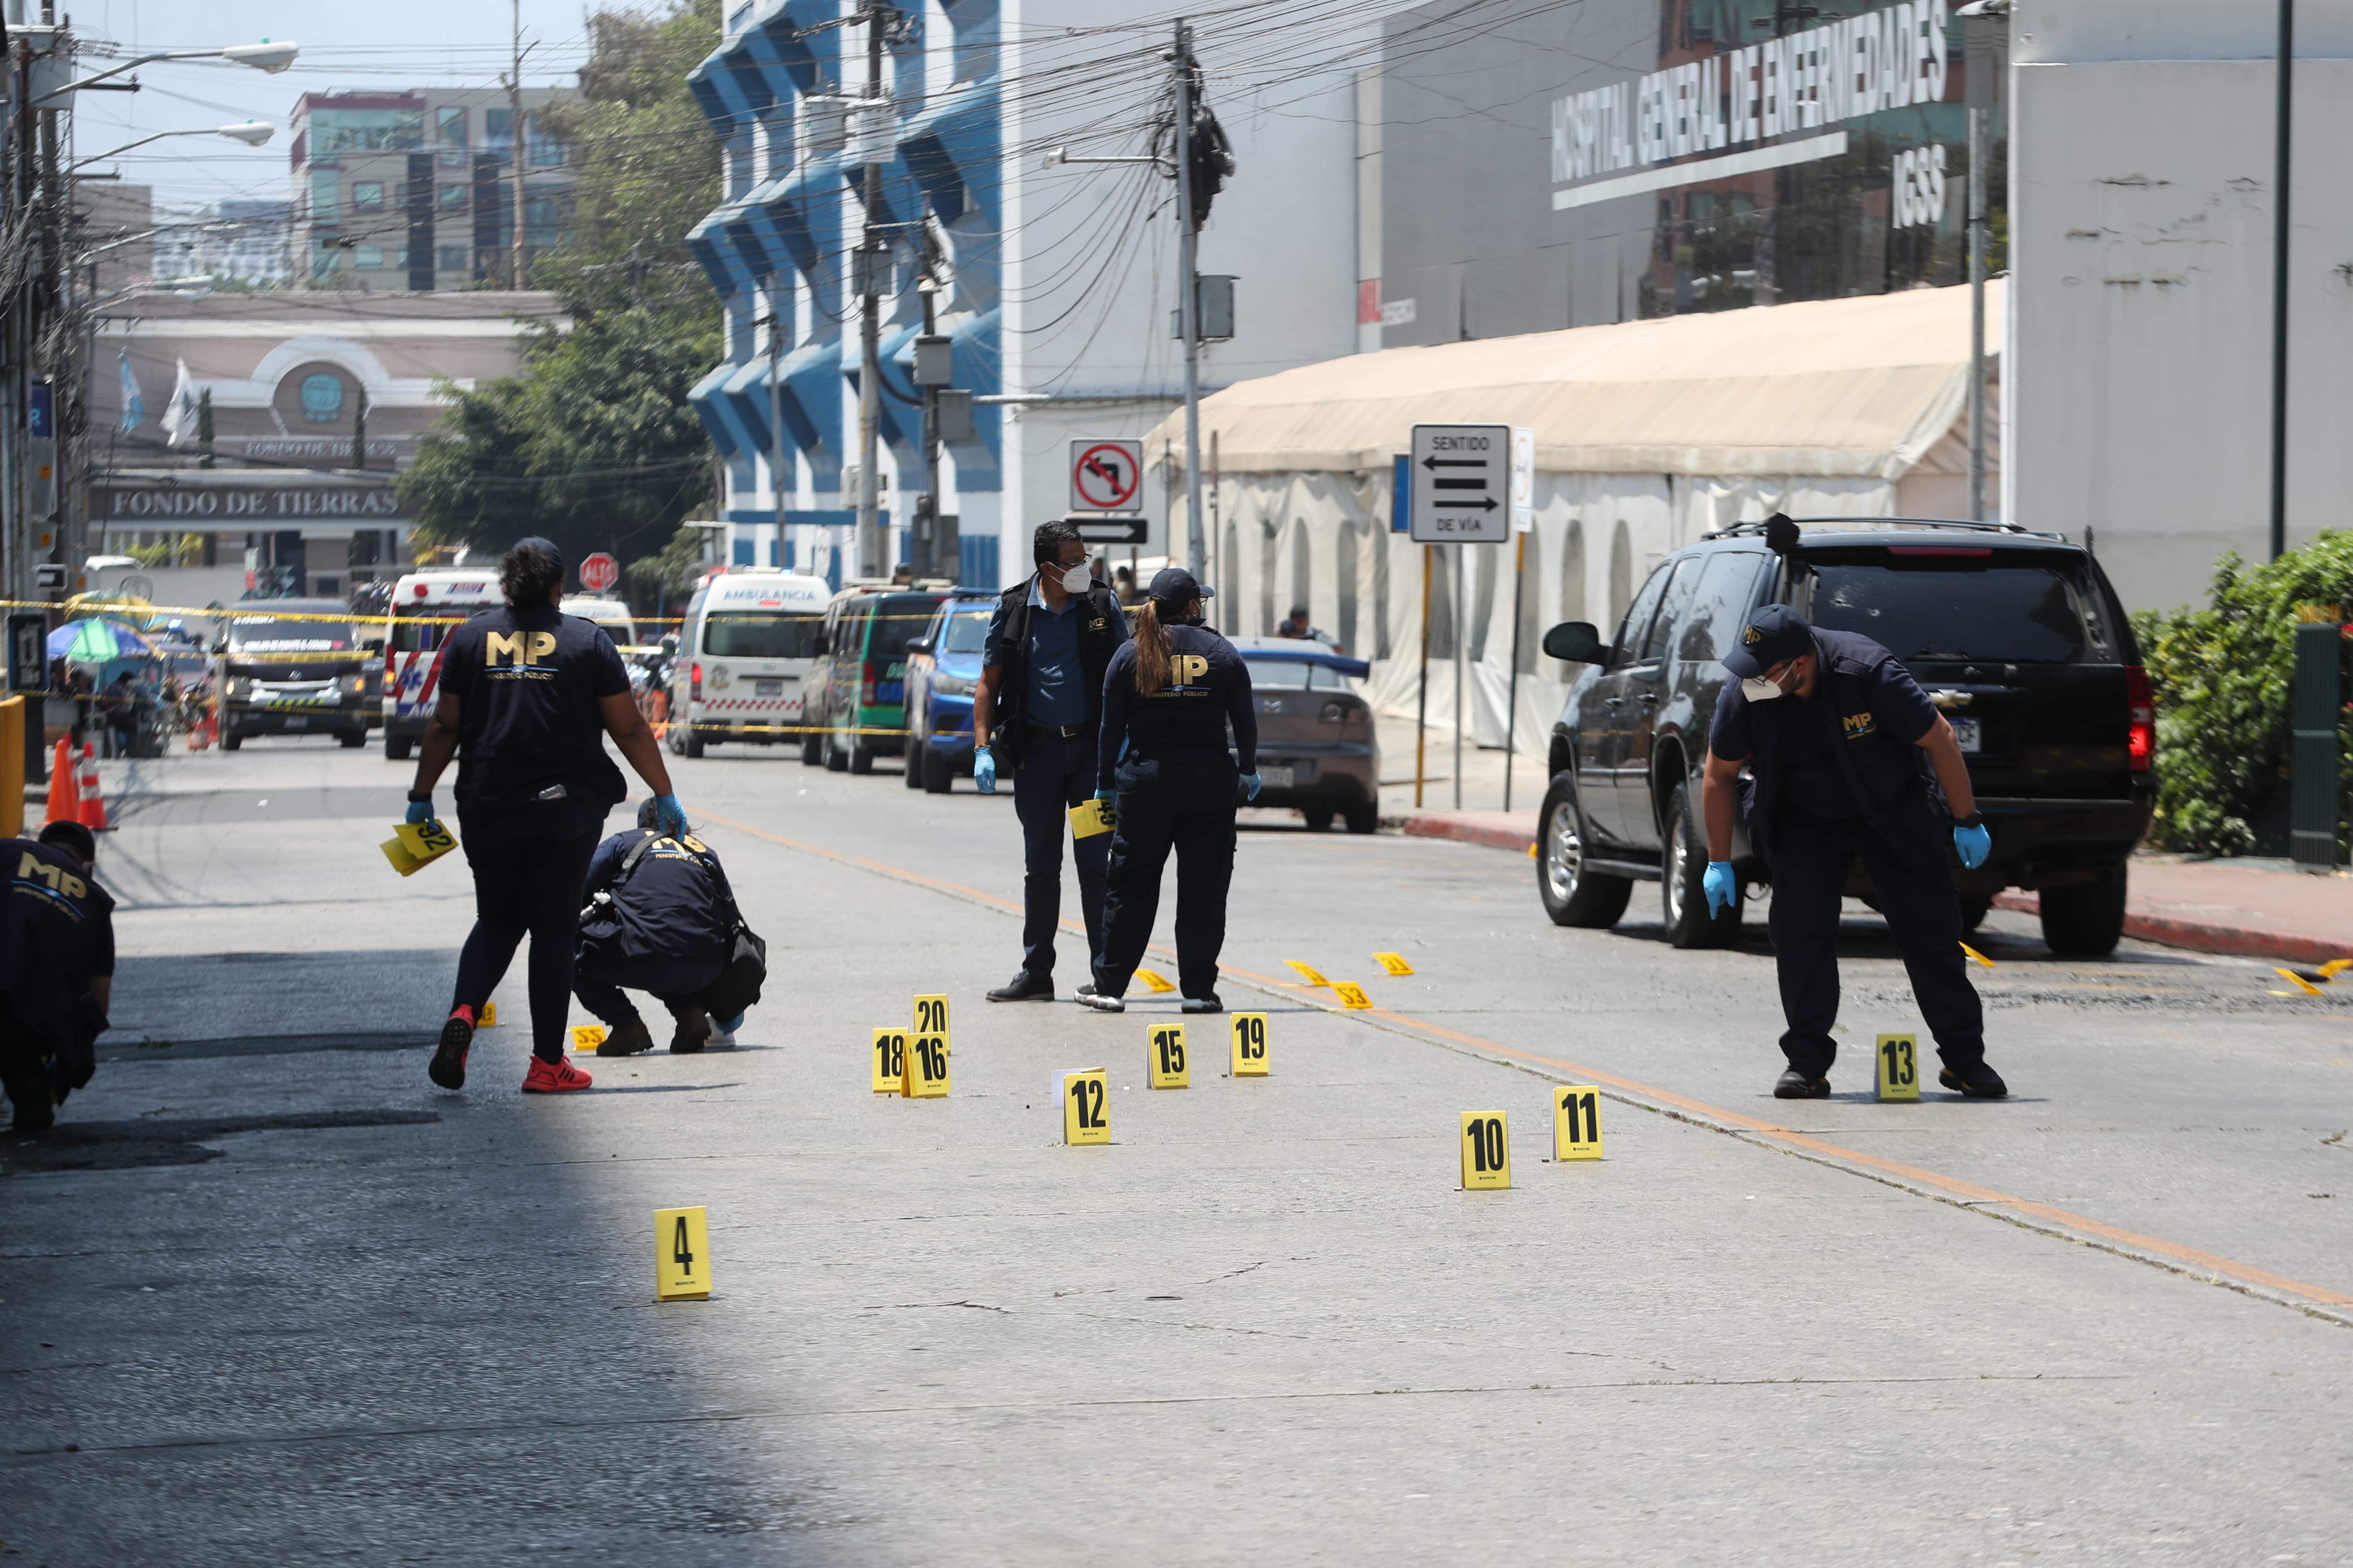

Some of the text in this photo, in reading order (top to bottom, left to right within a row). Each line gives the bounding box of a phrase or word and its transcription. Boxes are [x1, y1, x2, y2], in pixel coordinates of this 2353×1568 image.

[1552, 0, 1947, 183] HOSPITAL GENERAL DE ENFERMEDADES
[1892, 144, 1947, 229] IGSS
[1432, 436, 1489, 451] SENTIDO
[114, 490, 398, 515] FONDO DE TIERRAS
[1436, 515, 1483, 531] DE VÍA
[584, 562, 618, 583] ALTO
[724, 589, 816, 601] AMBULANCIA
[1089, 617, 1105, 628] MP
[1743, 624, 1760, 643] MP
[486, 630, 557, 666] MP
[1842, 712, 1872, 731] MP
[17, 851, 87, 899] MP
[918, 1000, 946, 1034] 20
[1235, 1017, 1265, 1059] 19
[876, 1035, 904, 1078] 18
[915, 1038, 947, 1081] 16
[1154, 1030, 1185, 1074] 15
[1882, 1040, 1914, 1085] 13
[1071, 1079, 1106, 1128] 12
[1561, 1092, 1598, 1143] 11
[1467, 1118, 1505, 1172] 10
[674, 1216, 693, 1276] 4
